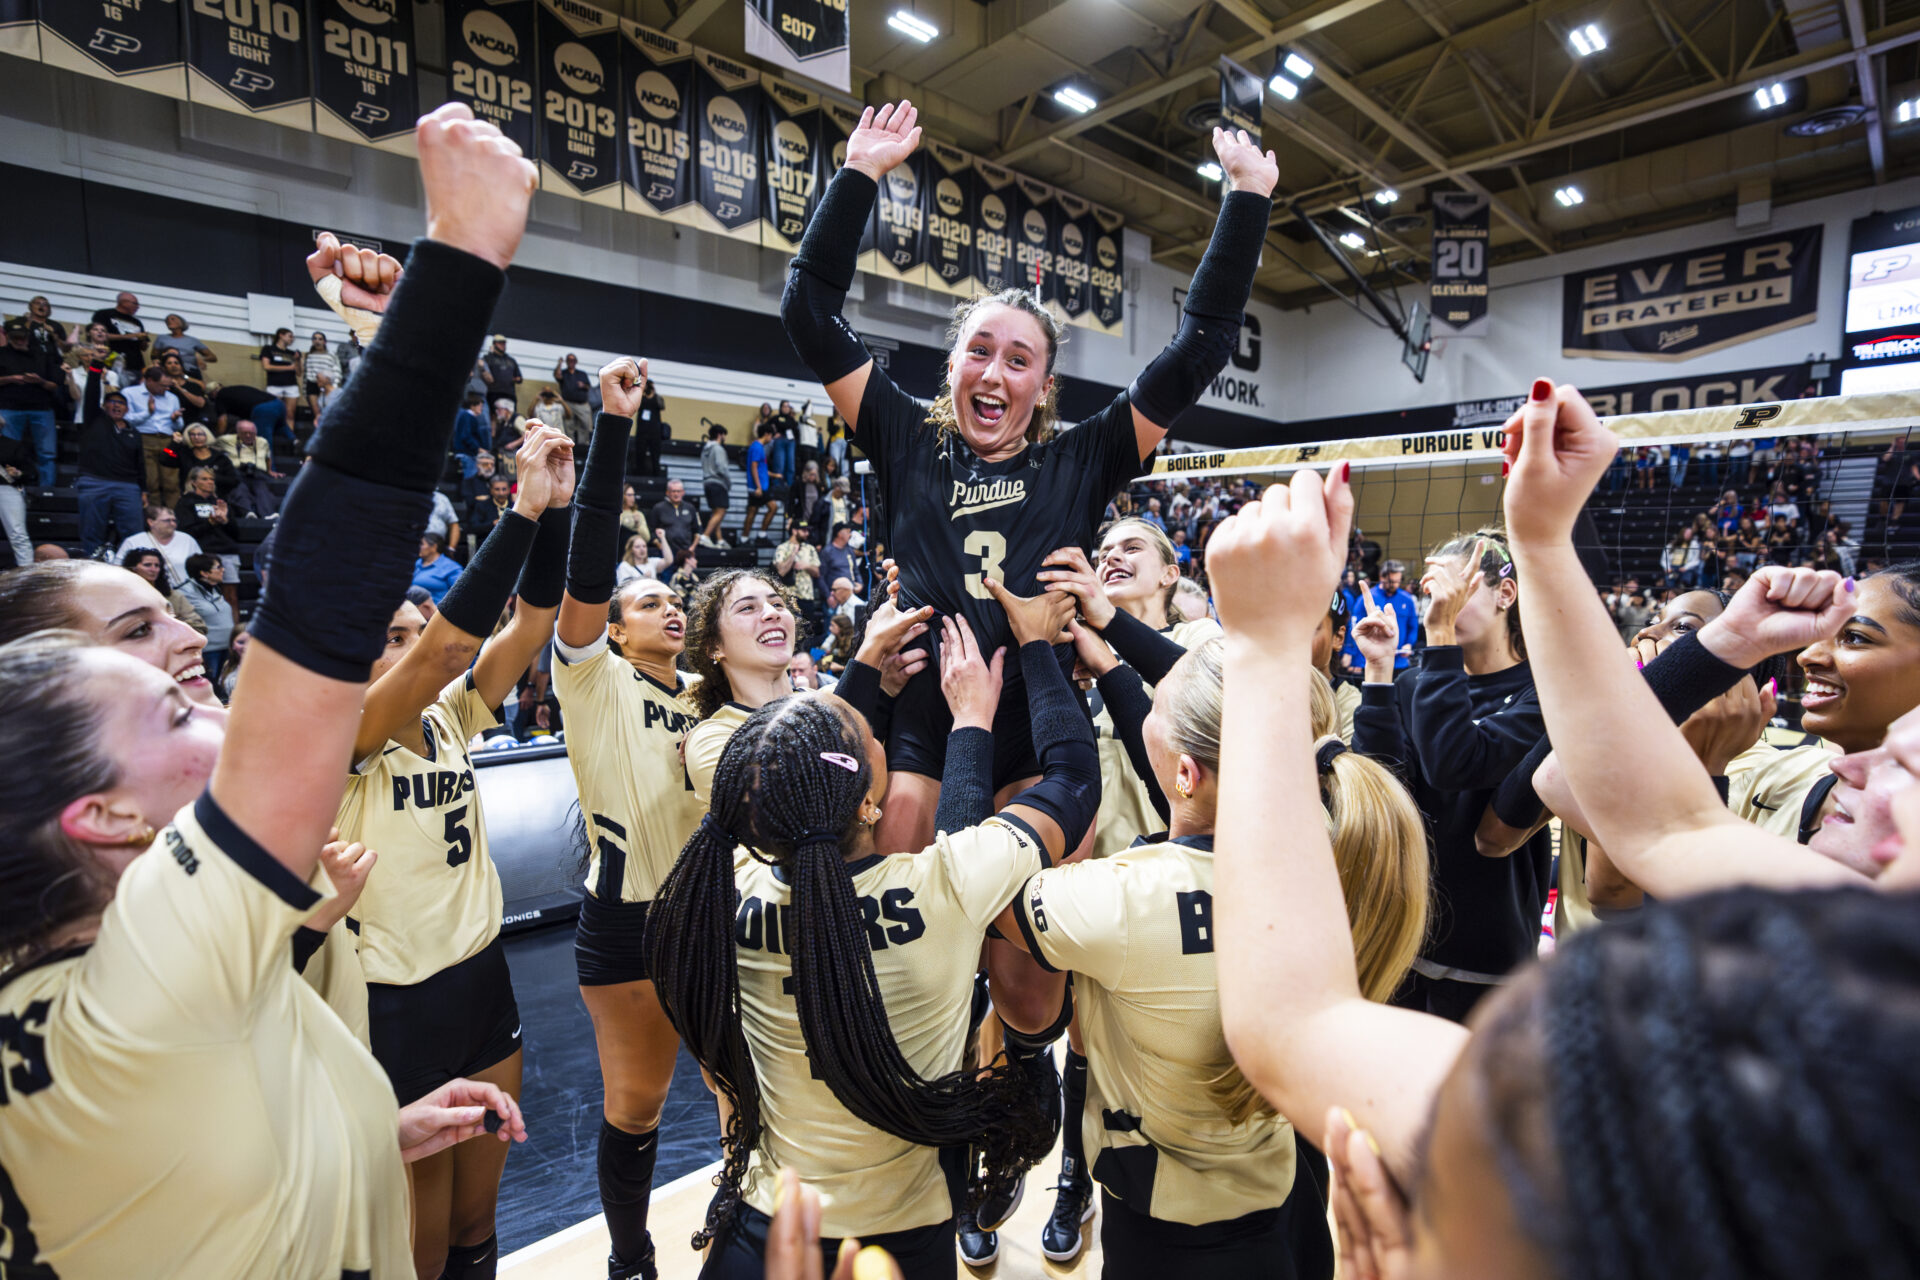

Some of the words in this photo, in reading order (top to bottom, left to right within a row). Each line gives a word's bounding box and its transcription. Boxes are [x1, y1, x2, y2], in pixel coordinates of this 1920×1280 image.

[102, 3, 123, 22] 16
[228, 25, 269, 50] ELITE
[635, 27, 679, 54] PURDUE
[781, 13, 816, 42] 2017
[228, 40, 271, 65] EIGHT
[324, 18, 407, 75] 2011
[469, 30, 515, 59] NCAA
[345, 60, 390, 86] SWEET
[560, 61, 603, 87] NCAA
[707, 54, 748, 79] PURDUE
[361, 80, 376, 96] 16
[452, 60, 532, 113] 2012
[641, 89, 679, 113] NCAA
[473, 100, 513, 123] SWEET
[545, 89, 616, 138] 2013
[712, 113, 746, 135] NCAA
[568, 127, 595, 145] ELITE
[628, 116, 690, 160] 2015
[779, 136, 808, 156] NCAA
[700, 139, 757, 180] 2016
[767, 159, 817, 198] 2017
[880, 197, 923, 231] 2019
[929, 213, 971, 246] 2020
[976, 228, 1012, 259] 2021
[1017, 242, 1053, 272] 2022
[1055, 254, 1089, 283] 2023
[1437, 240, 1483, 277] 20
[1091, 266, 1122, 294] 2024
[1585, 241, 1793, 303] EVER
[1431, 284, 1488, 296] CLEVELAND
[1591, 286, 1784, 327] GRATEFUL
[1402, 432, 1473, 455] PURDUE
[1167, 455, 1207, 471] BOILER
[1209, 453, 1225, 468] UP
[949, 479, 1026, 515] Purdue
[964, 530, 1007, 599] 3
[444, 805, 471, 868] 5
